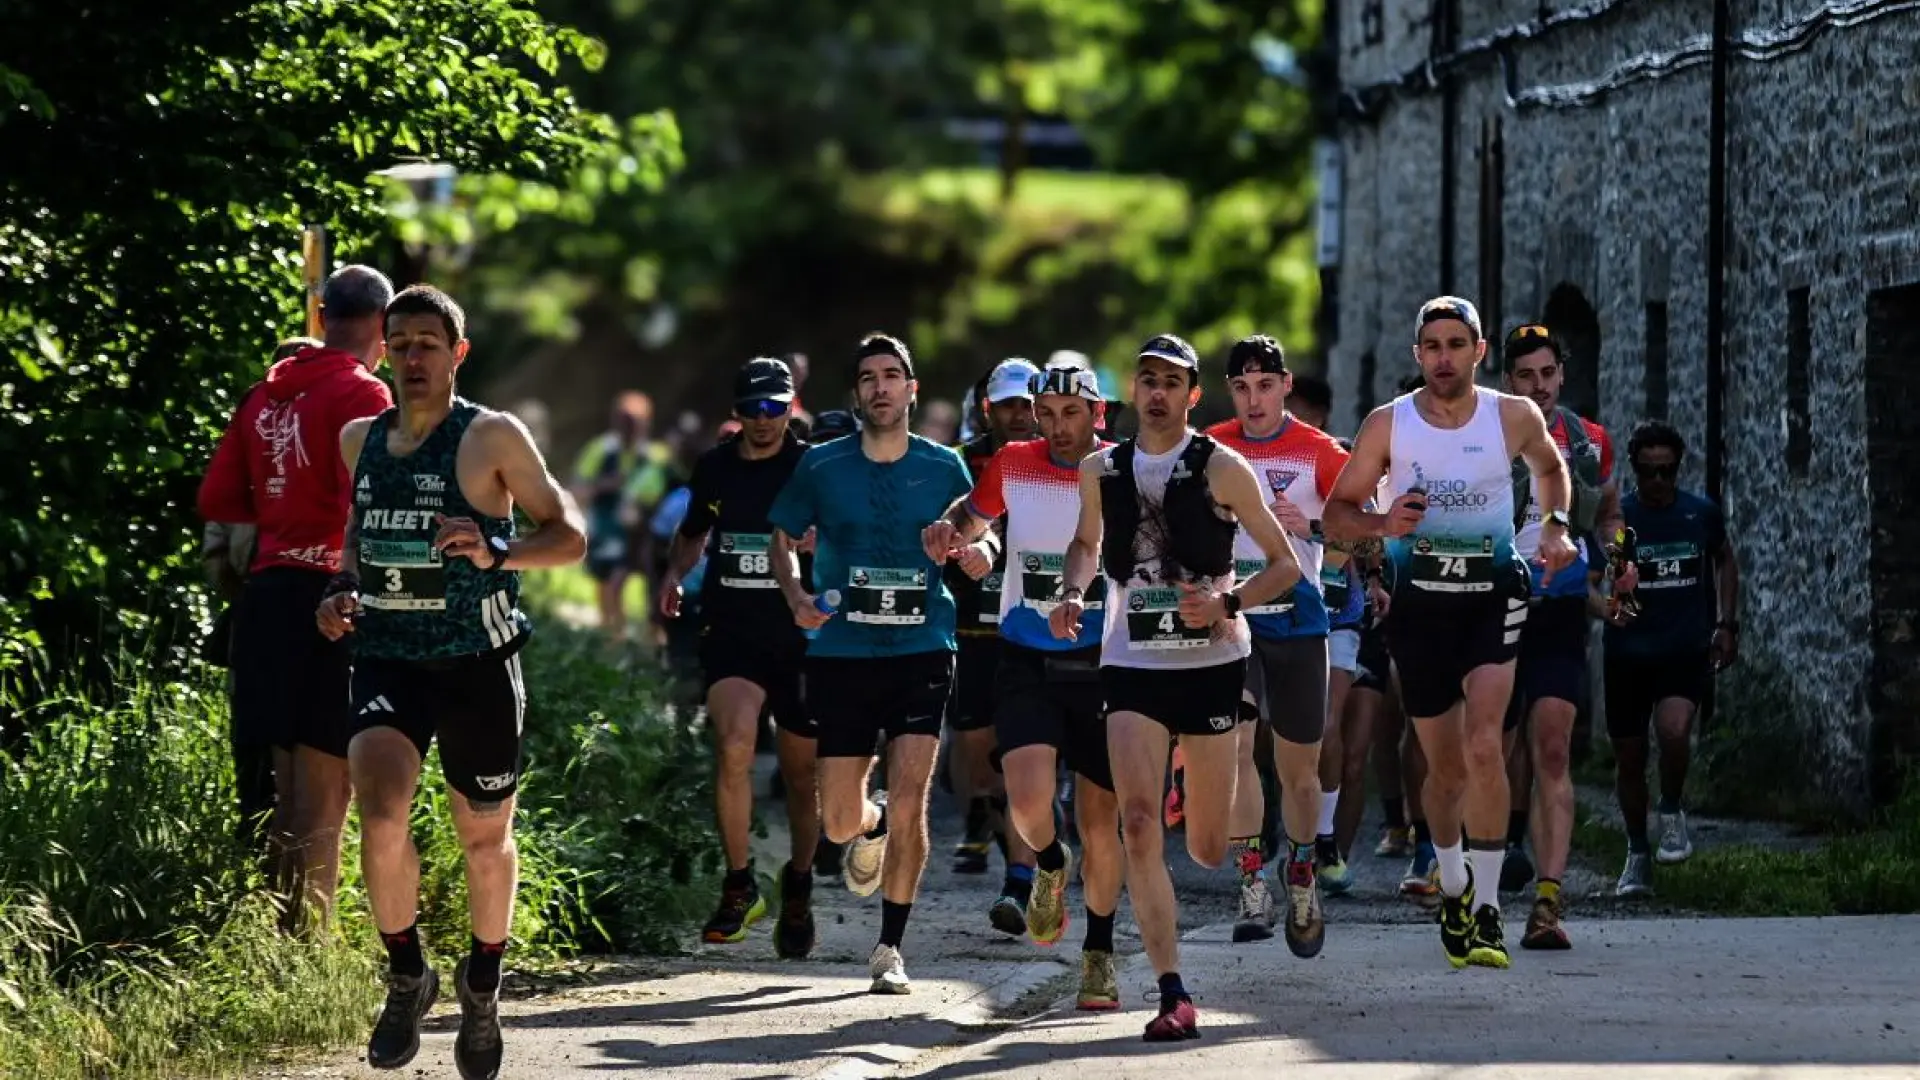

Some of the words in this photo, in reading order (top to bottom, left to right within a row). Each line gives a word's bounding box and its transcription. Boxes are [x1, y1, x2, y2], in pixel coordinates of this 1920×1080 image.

[1426, 480, 1467, 494] FISIO
[1428, 494, 1488, 512] espacio
[362, 509, 436, 530] ATLEET
[739, 554, 770, 574] 68
[1438, 558, 1468, 577] 74
[1657, 560, 1681, 576] 54
[385, 568, 402, 592] 3
[880, 590, 896, 610] 5
[1158, 611, 1175, 633] 4
